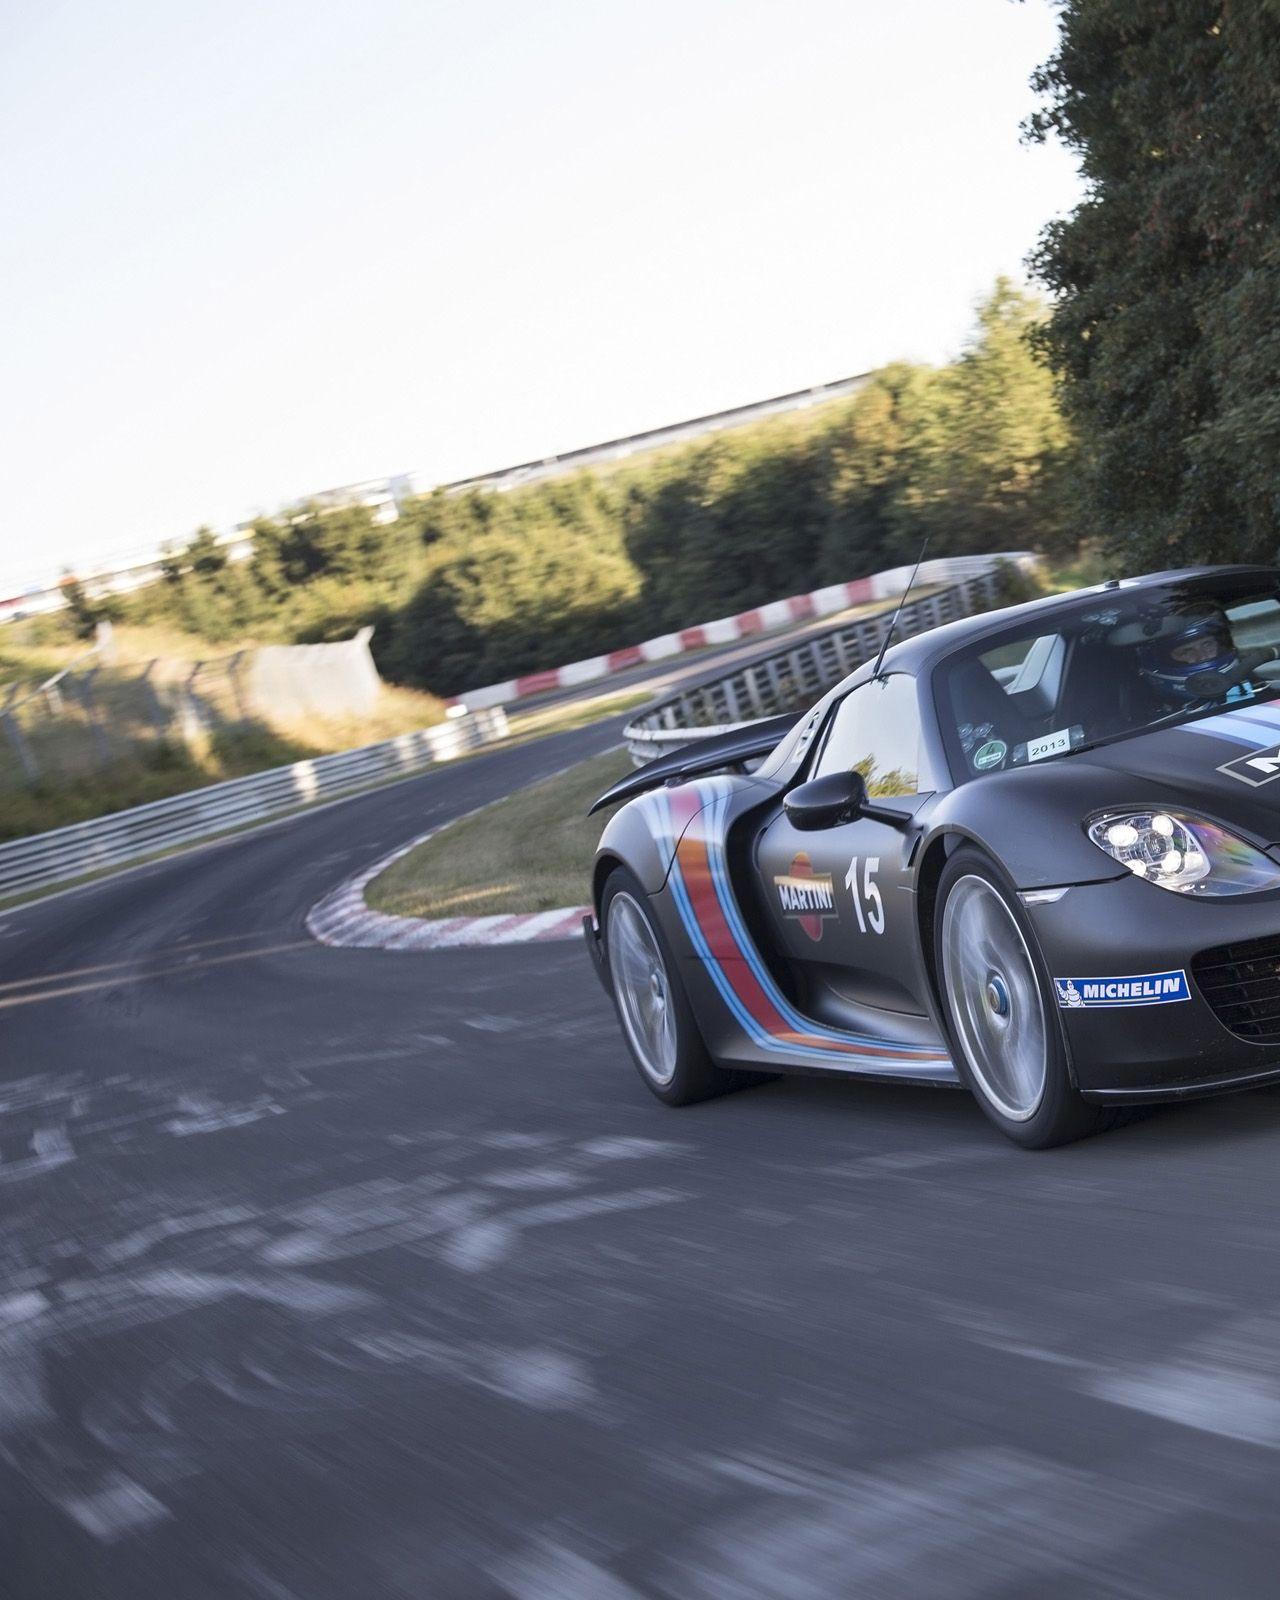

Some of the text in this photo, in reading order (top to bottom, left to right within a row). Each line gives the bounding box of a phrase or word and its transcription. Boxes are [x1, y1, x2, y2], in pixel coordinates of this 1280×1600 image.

[1031, 739, 1066, 756] 2013
[778, 882, 833, 911] MARTINI
[845, 856, 885, 935] 15
[1083, 977, 1181, 999] MICHELIN
